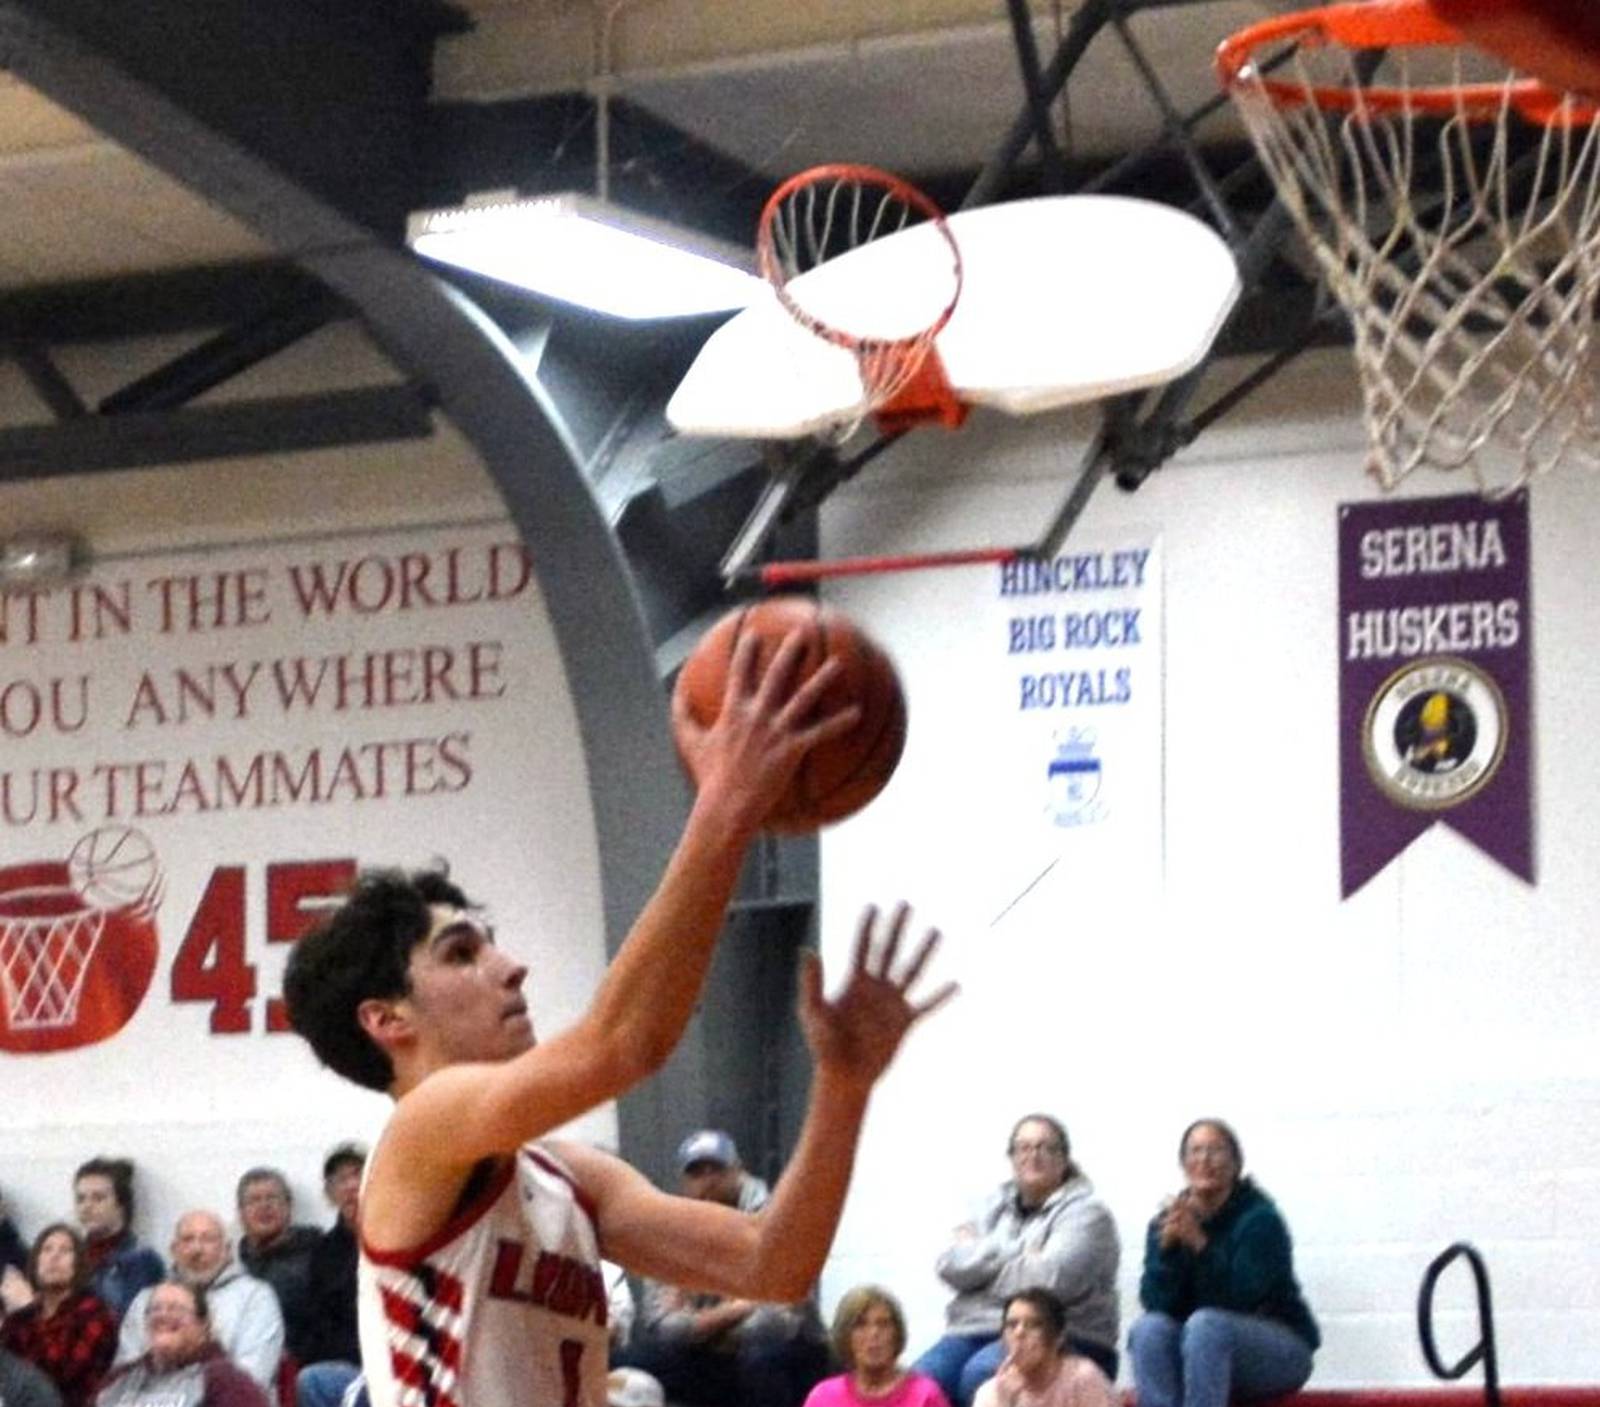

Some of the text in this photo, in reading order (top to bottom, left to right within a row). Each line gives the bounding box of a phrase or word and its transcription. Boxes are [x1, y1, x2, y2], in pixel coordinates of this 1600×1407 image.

[999, 548, 1151, 597] HINCKLEY
[1360, 519, 1506, 580] SERENA
[68, 578, 133, 642] IN
[146, 567, 272, 634] THE
[287, 542, 533, 617] WORLD
[1007, 608, 1141, 655] BIG ROCK
[1346, 598, 1520, 661] HUSKERS
[125, 640, 507, 728] ANYWHERE
[1019, 666, 1132, 711] ROYALS
[2, 732, 473, 825] UR TEAMMATES
